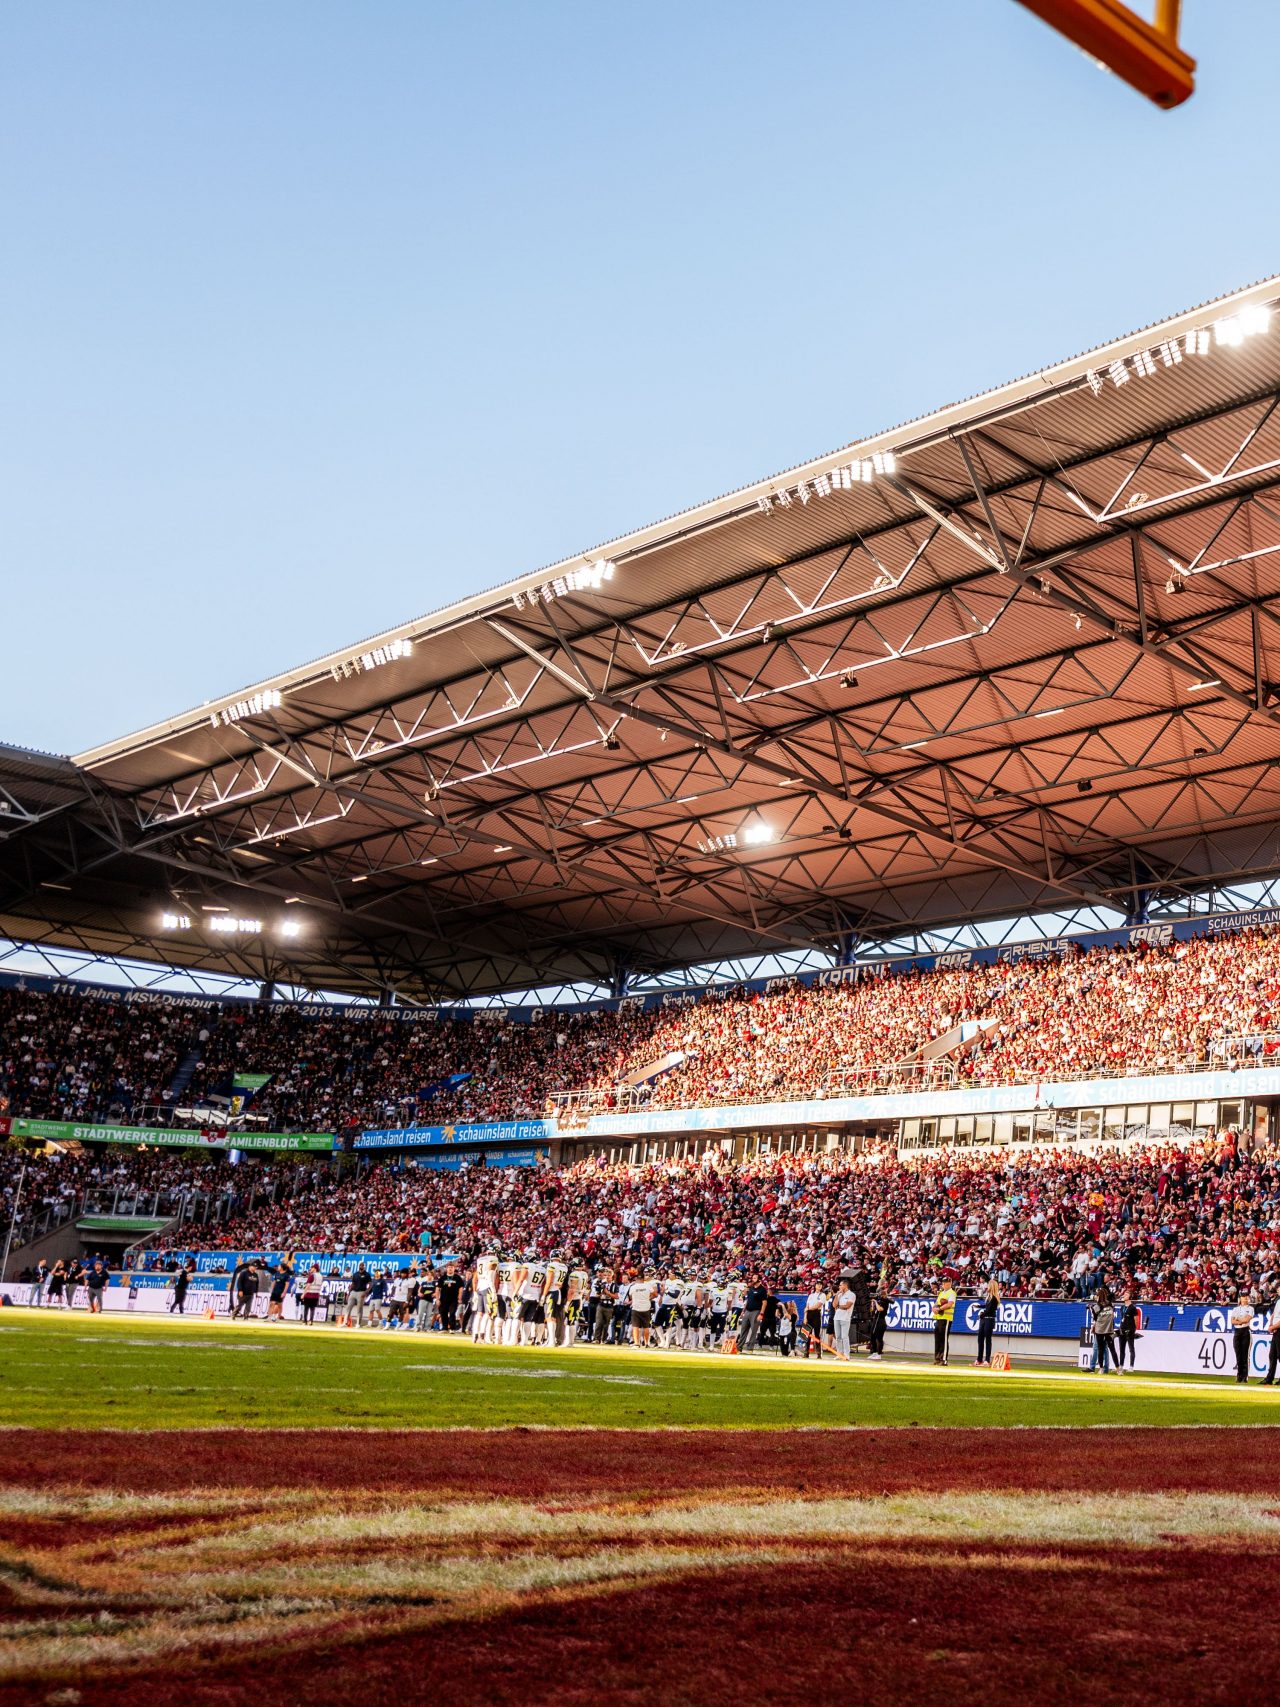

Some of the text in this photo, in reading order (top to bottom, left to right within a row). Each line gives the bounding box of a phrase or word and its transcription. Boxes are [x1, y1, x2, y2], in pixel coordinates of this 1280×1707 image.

[1128, 924, 1174, 946] 1902
[1012, 938, 1070, 956] RHENUS
[52, 982, 77, 996] 111
[80, 986, 122, 1001] Jahre
[124, 990, 161, 1006] MSV
[345, 1008, 371, 1020] WIR
[585, 1114, 648, 1134] chauinsland
[723, 1103, 850, 1127] schauinsland reisen
[73, 1126, 201, 1145] STADTWERKE DUISBU
[405, 1129, 431, 1145] reisen
[458, 1124, 517, 1142] schauinsland
[518, 1121, 549, 1138] reisen
[223, 1136, 300, 1149] FAMILIENBLOCK
[365, 1257, 399, 1275] reisen
[531, 1271, 546, 1284] 67
[715, 1296, 722, 1306] 2
[901, 1299, 935, 1317] max
[901, 1318, 936, 1330] NUTRITI
[993, 1320, 1033, 1334] UTRITION
[993, 1354, 1006, 1369] 20
[1198, 1337, 1227, 1370] 40
